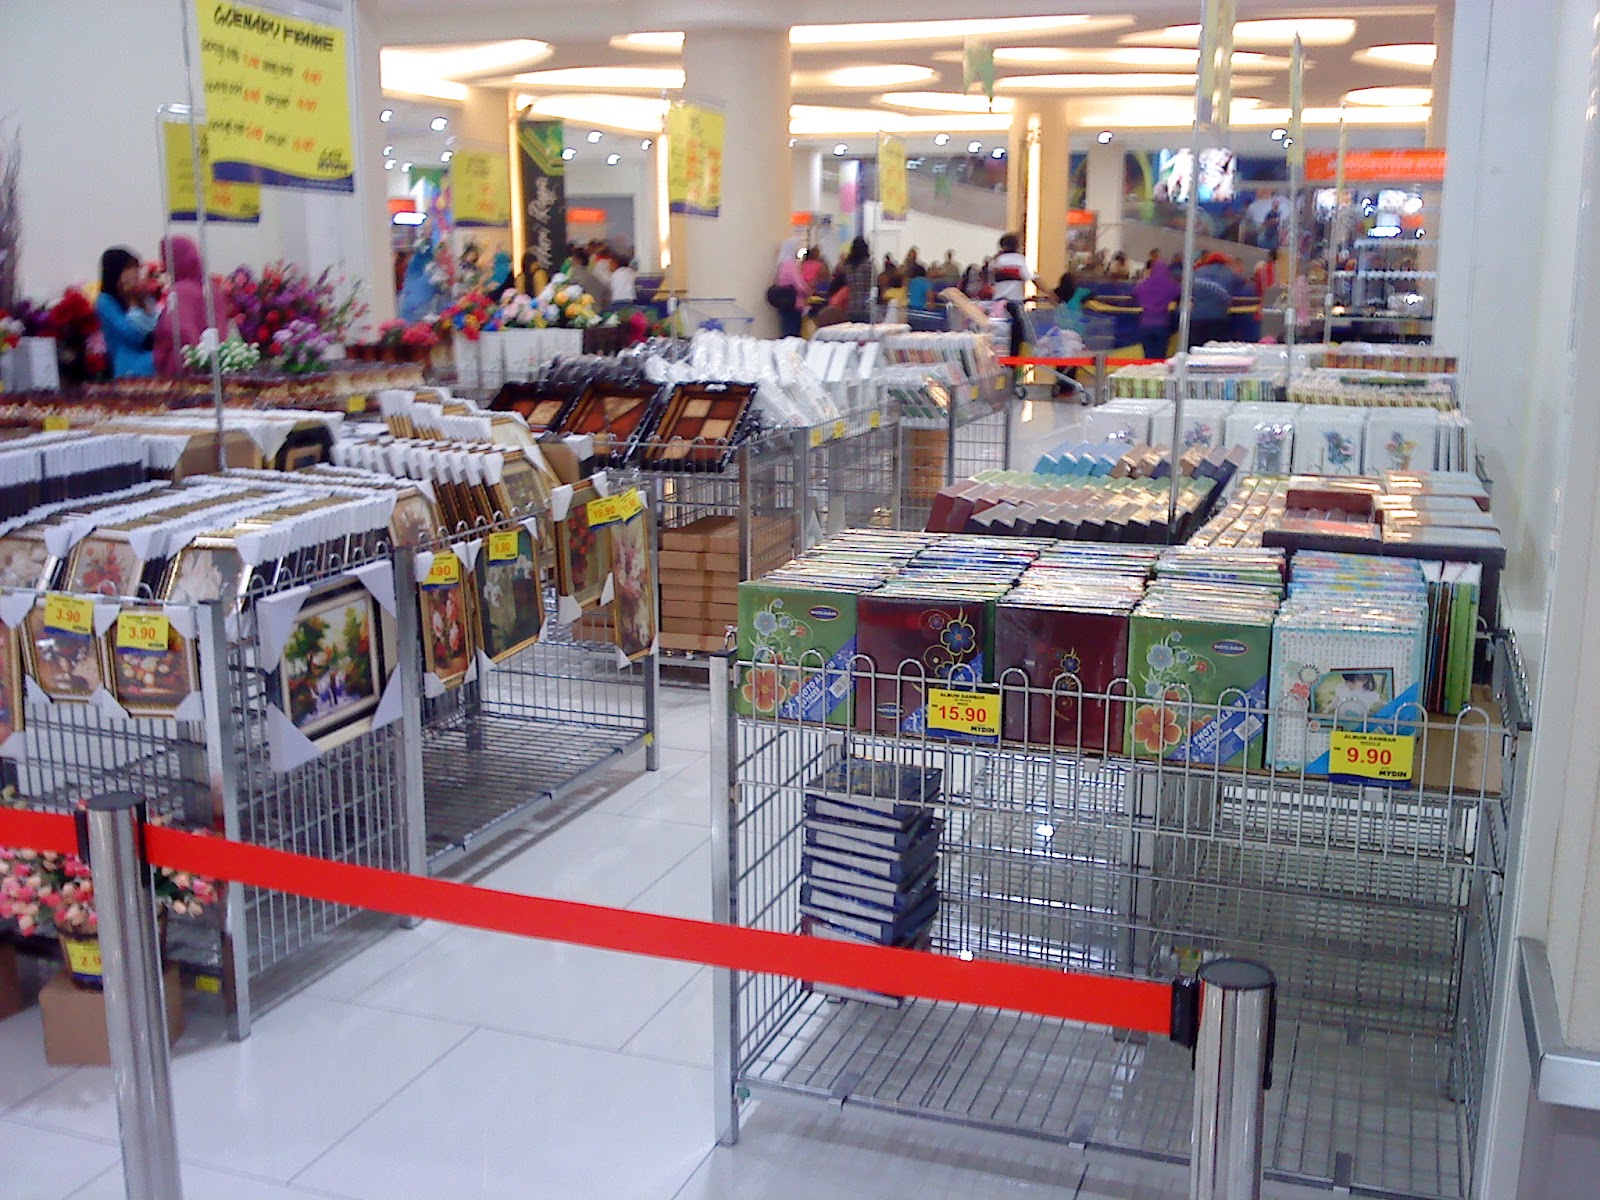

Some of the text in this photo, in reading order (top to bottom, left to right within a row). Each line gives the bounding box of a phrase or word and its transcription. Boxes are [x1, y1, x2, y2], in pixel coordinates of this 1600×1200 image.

[55, 607, 81, 624] 3.90
[128, 626, 156, 641] 3.90
[938, 705, 987, 723] 15.90
[970, 725, 995, 734] MYDIN
[1347, 747, 1392, 766] 9.90
[1378, 769, 1407, 778] MYDIN
